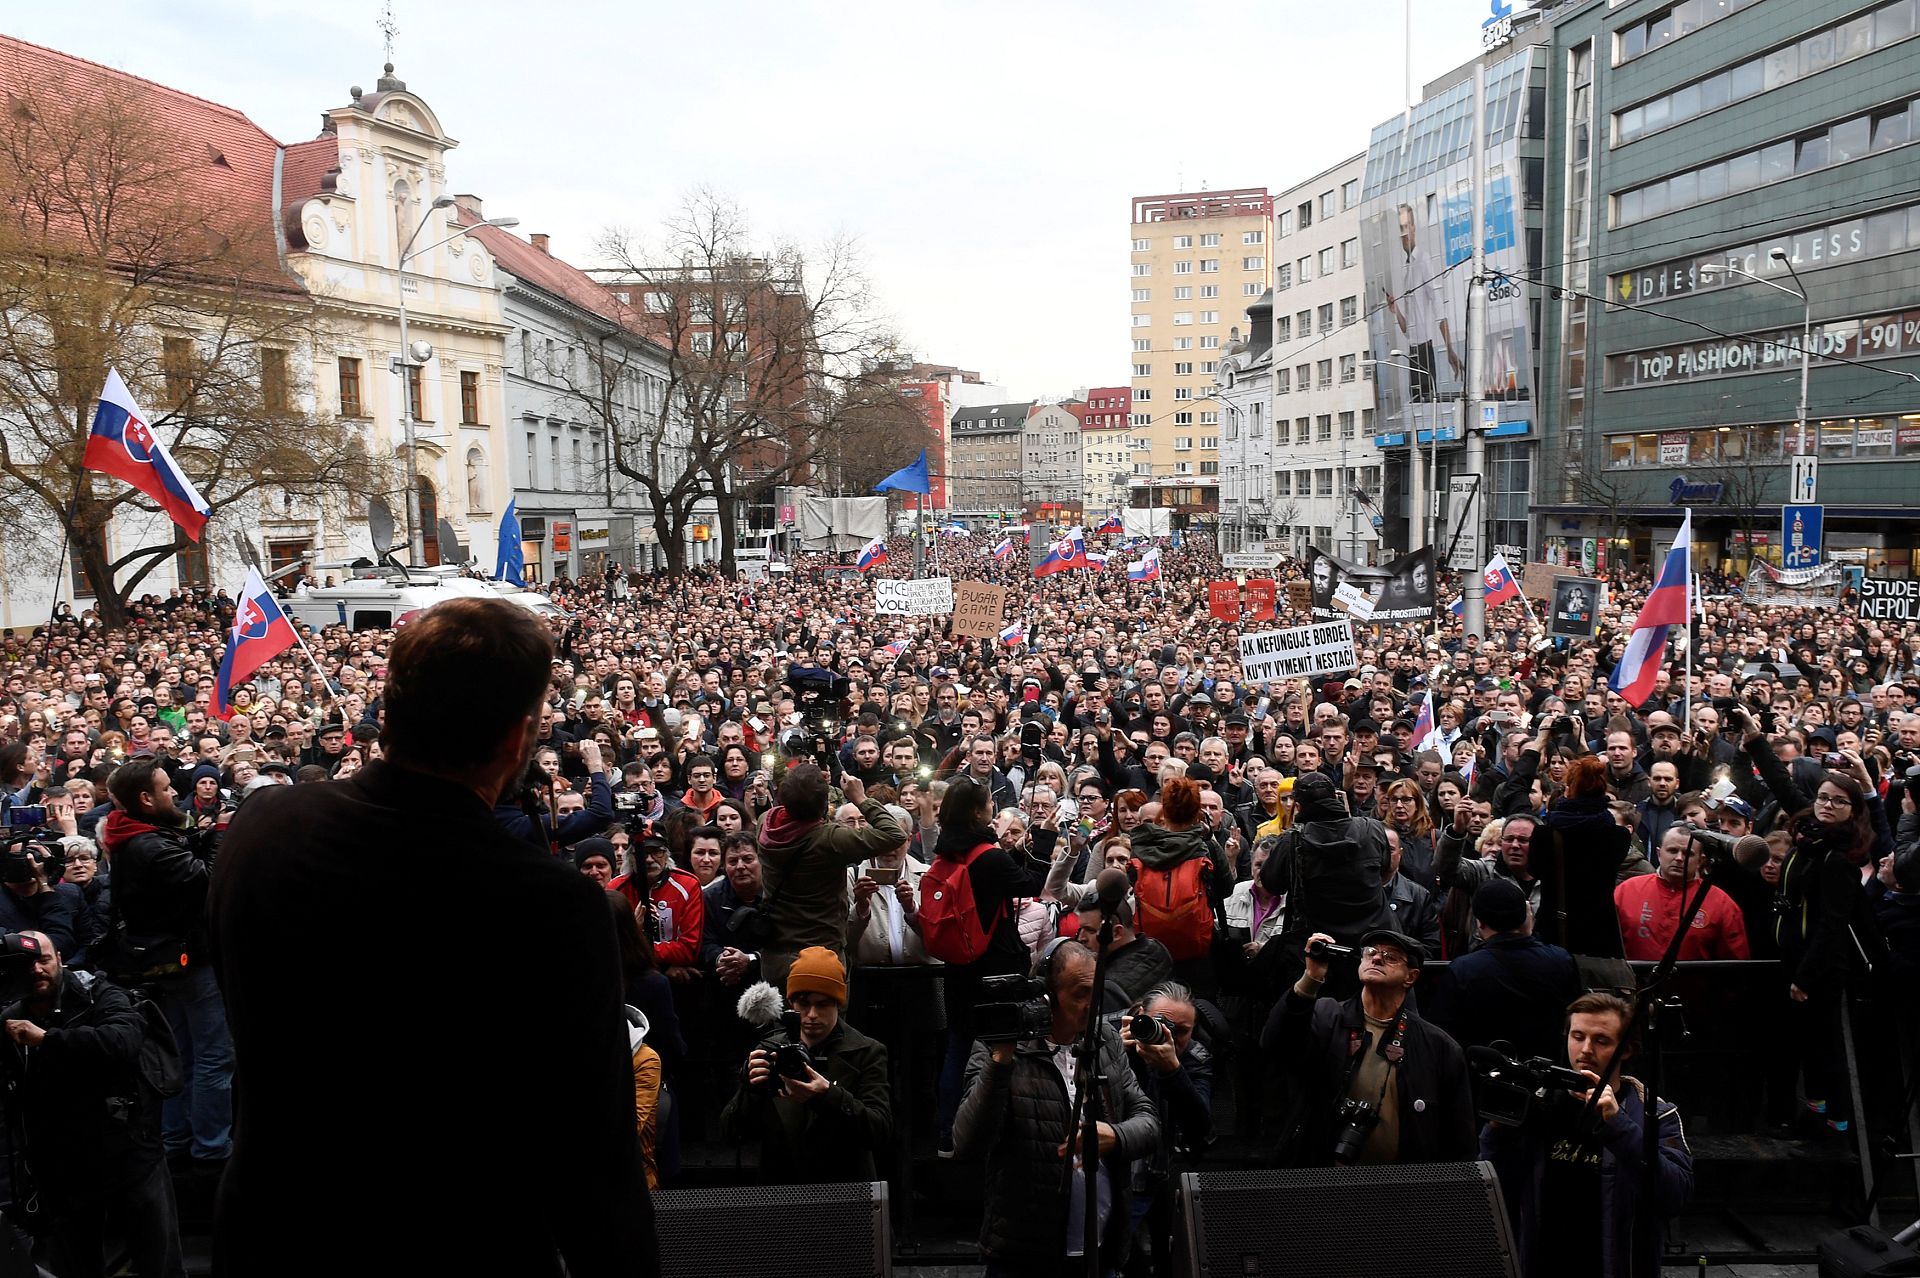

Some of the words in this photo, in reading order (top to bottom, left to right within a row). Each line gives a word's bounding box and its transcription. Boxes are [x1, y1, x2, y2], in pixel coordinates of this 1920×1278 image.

[1791, 228, 1862, 263] LESS
[1641, 355, 1673, 379] TOP
[1677, 344, 1757, 374] FASHION
[1762, 332, 1847, 364] BRANDS
[1862, 577, 1920, 597] ŠTUDE
[961, 590, 999, 605] BUGÁR
[960, 603, 996, 616] GAME
[1391, 605, 1433, 619] PROSTITÚTKY
[958, 618, 996, 633] OVER
[1242, 639, 1255, 657] AK
[1256, 630, 1311, 654] NEFUNGUJE
[1312, 624, 1350, 646] BORDEL
[1274, 651, 1313, 677] VYMENIŤ
[1315, 645, 1355, 671] NESTAČÍ
